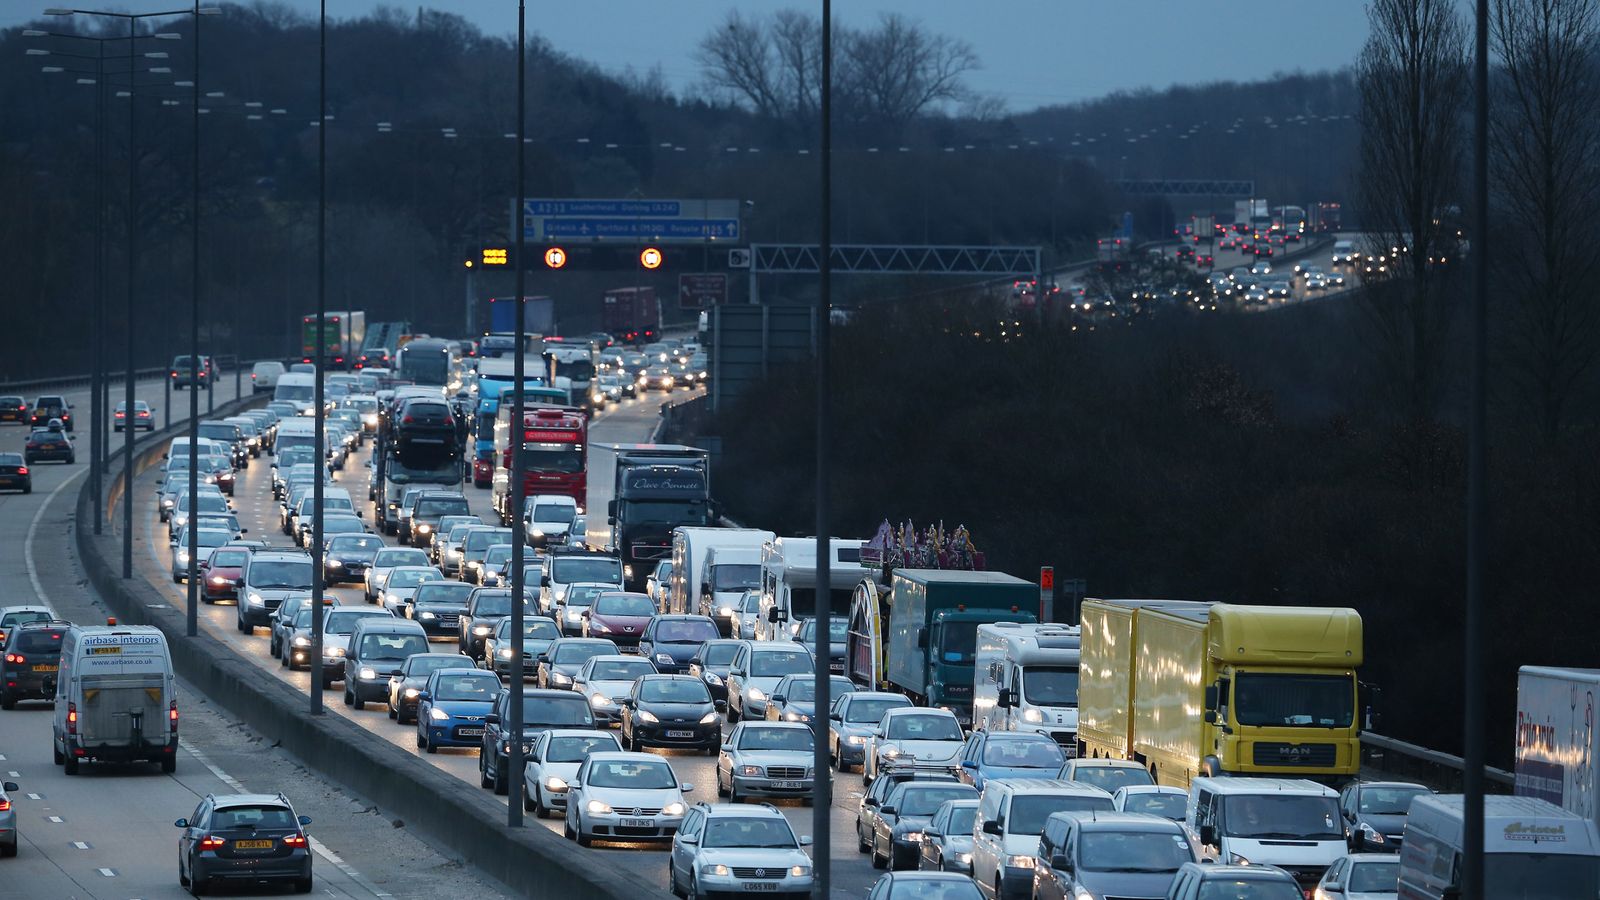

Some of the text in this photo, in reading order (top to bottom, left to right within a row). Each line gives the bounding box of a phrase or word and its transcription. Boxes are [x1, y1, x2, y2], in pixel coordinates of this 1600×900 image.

[633, 478, 697, 489] Dave Bennett
[84, 635, 159, 646] airbase interiors
[91, 657, 152, 666] www.airbase.co.uk
